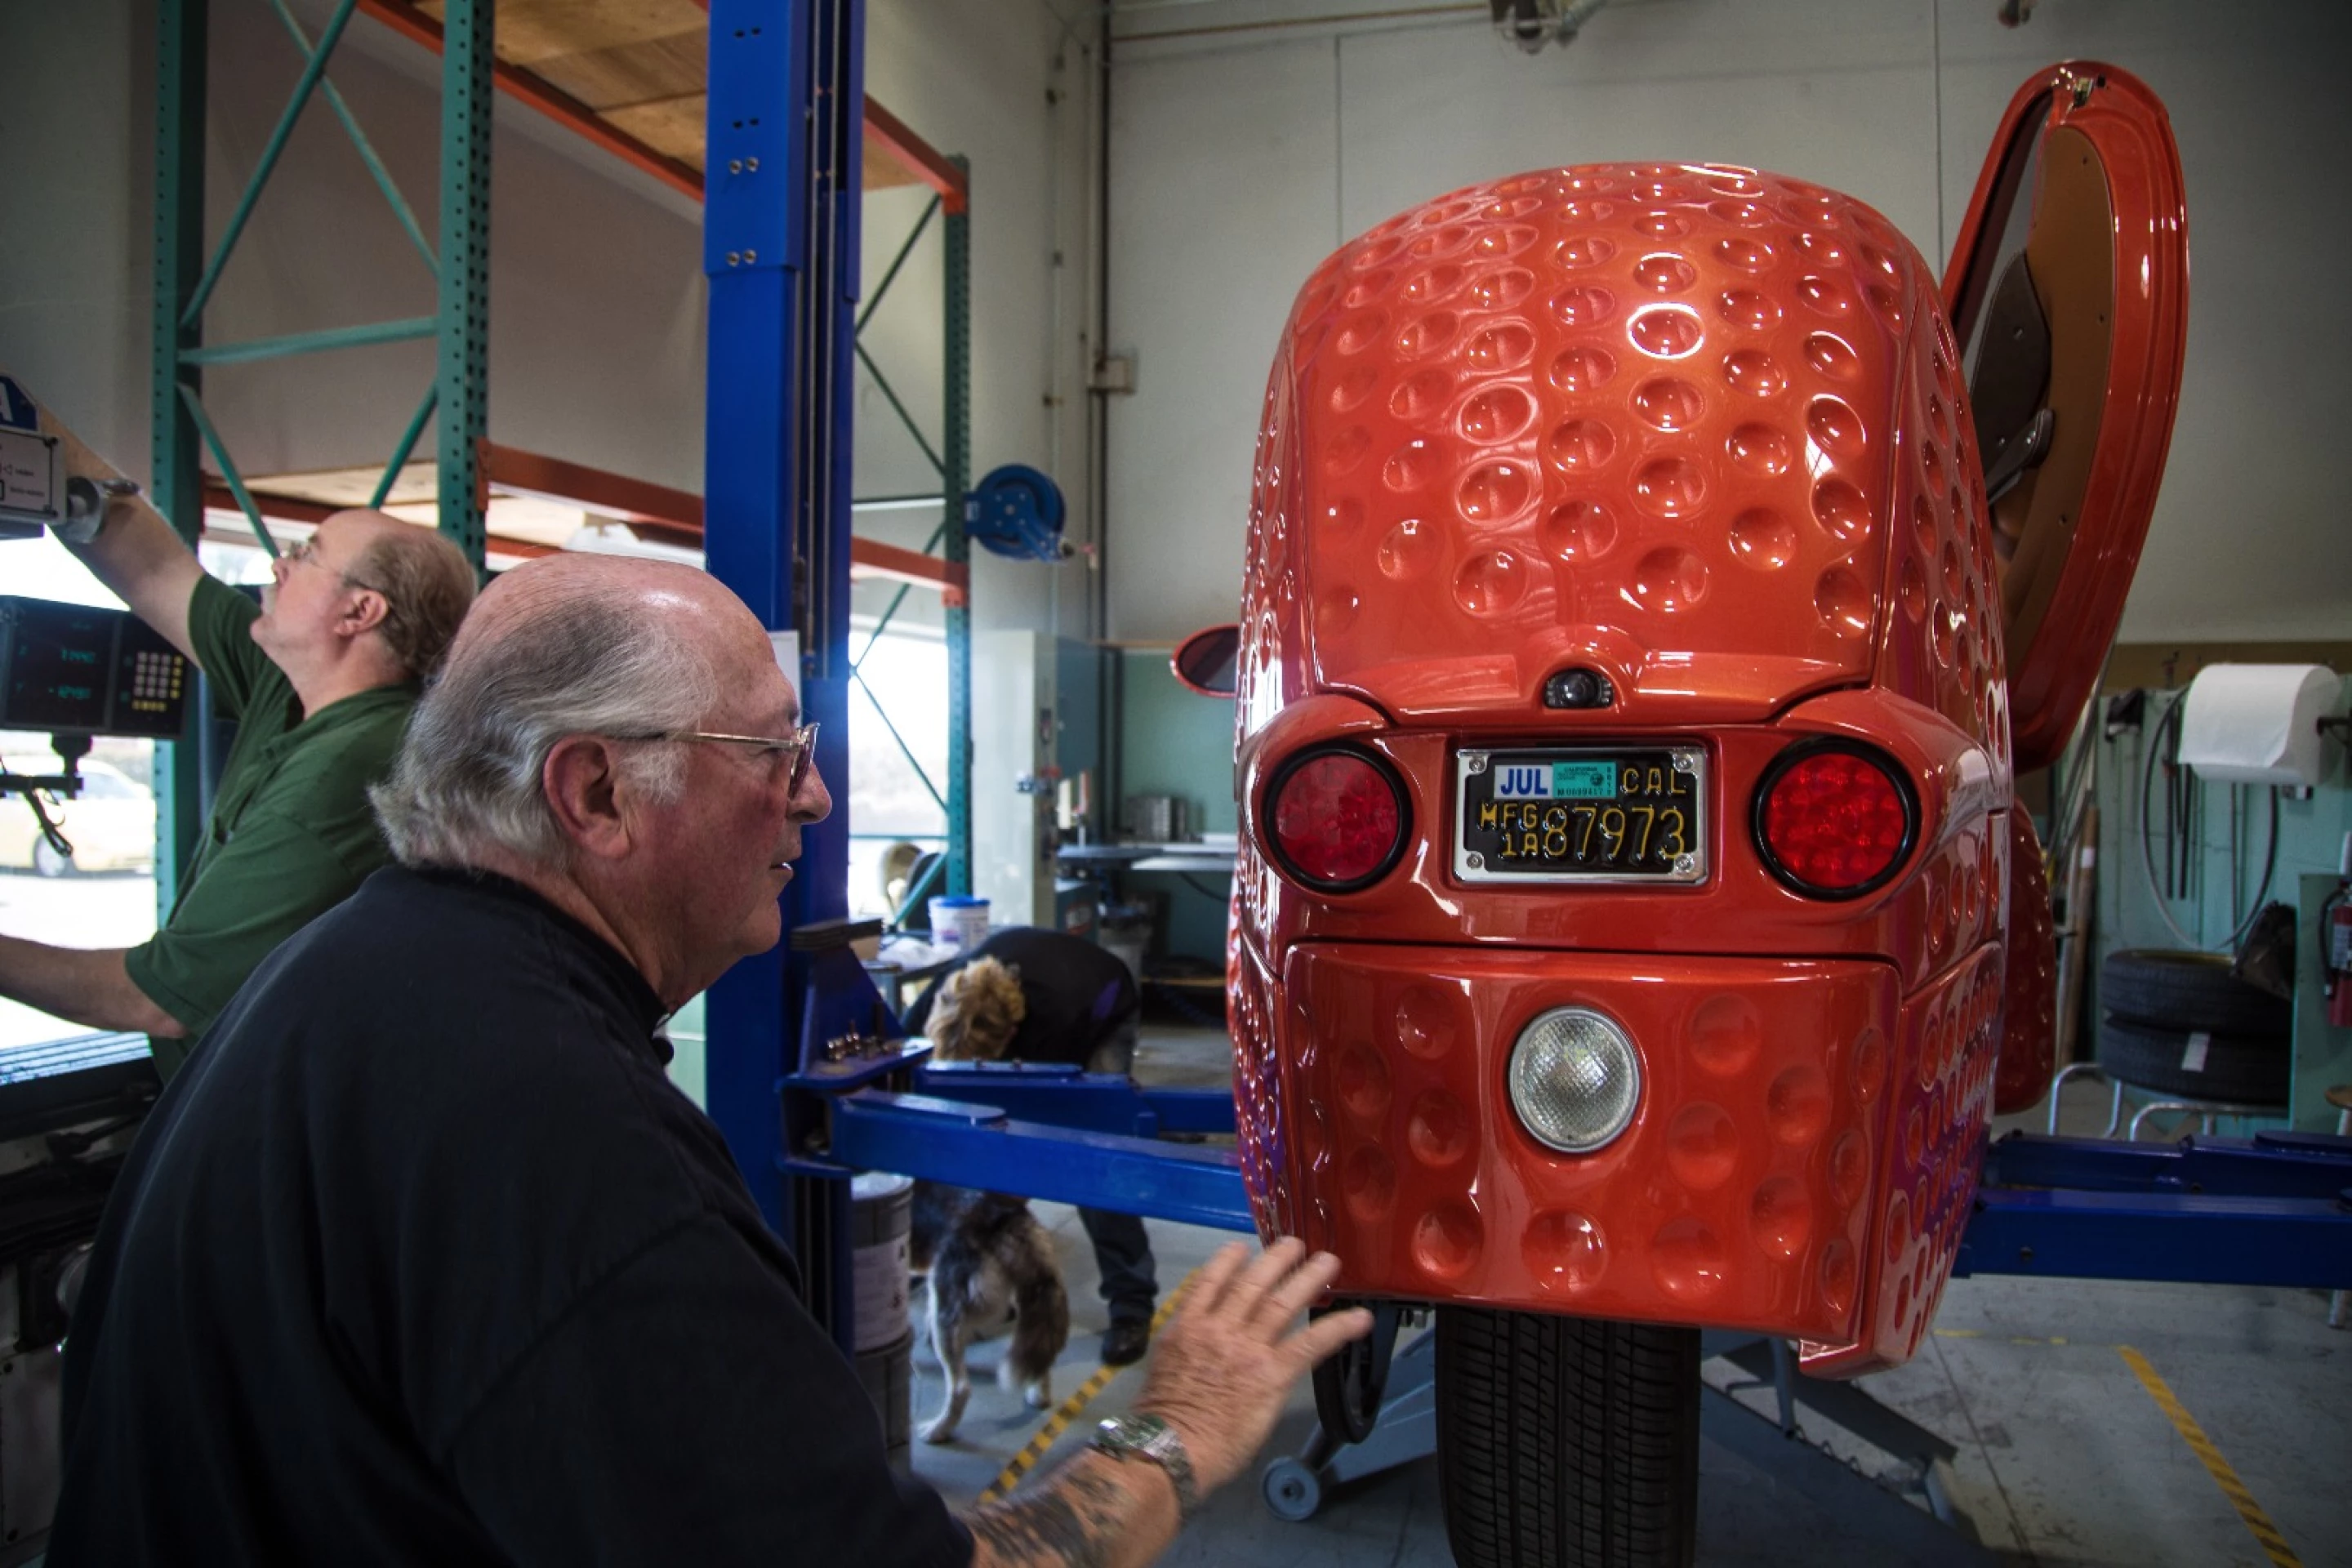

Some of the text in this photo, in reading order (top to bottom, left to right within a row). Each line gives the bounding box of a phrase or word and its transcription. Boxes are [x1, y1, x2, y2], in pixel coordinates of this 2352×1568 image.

[1500, 768, 1548, 795] JUL
[1624, 768, 1686, 794] CAL
[1480, 802, 1685, 859] MFG 87973
[1502, 832, 1539, 856] 1A
